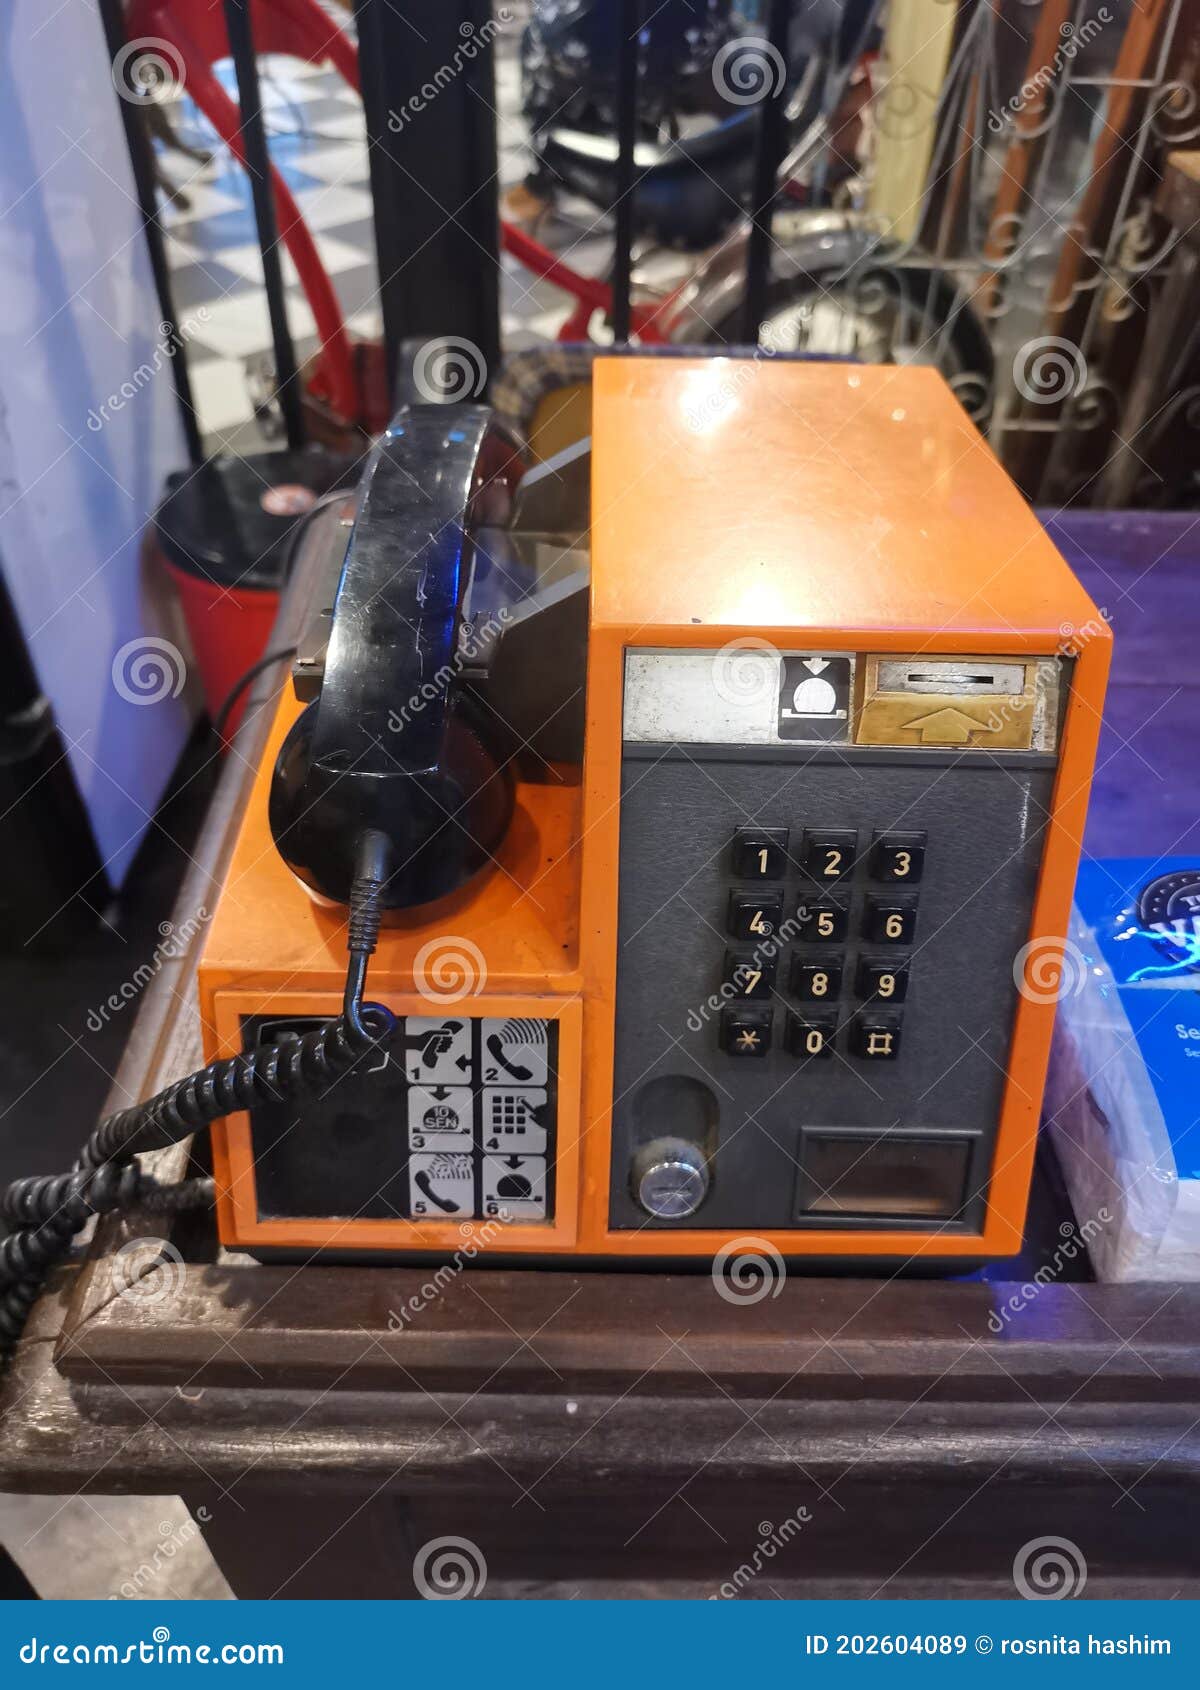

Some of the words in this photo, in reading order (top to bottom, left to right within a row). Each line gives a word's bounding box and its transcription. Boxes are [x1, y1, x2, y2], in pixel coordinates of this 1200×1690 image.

[757, 849, 768, 873] 1
[823, 850, 842, 875] 2
[893, 852, 911, 876] 3
[749, 911, 766, 934] 4
[817, 913, 834, 936] 5
[885, 914, 903, 938] 6
[745, 971, 761, 994] 7
[811, 973, 829, 996] 8
[878, 974, 896, 997] 9
[806, 1030, 823, 1054] 0
[411, 1068, 420, 1080] 1
[485, 1068, 498, 1081] 2
[433, 1106, 450, 1117] 10
[424, 1117, 458, 1129] SEN
[412, 1135, 425, 1148] 3
[486, 1137, 499, 1150] 4
[414, 1201, 427, 1214] 5
[486, 1202, 499, 1215] 6
